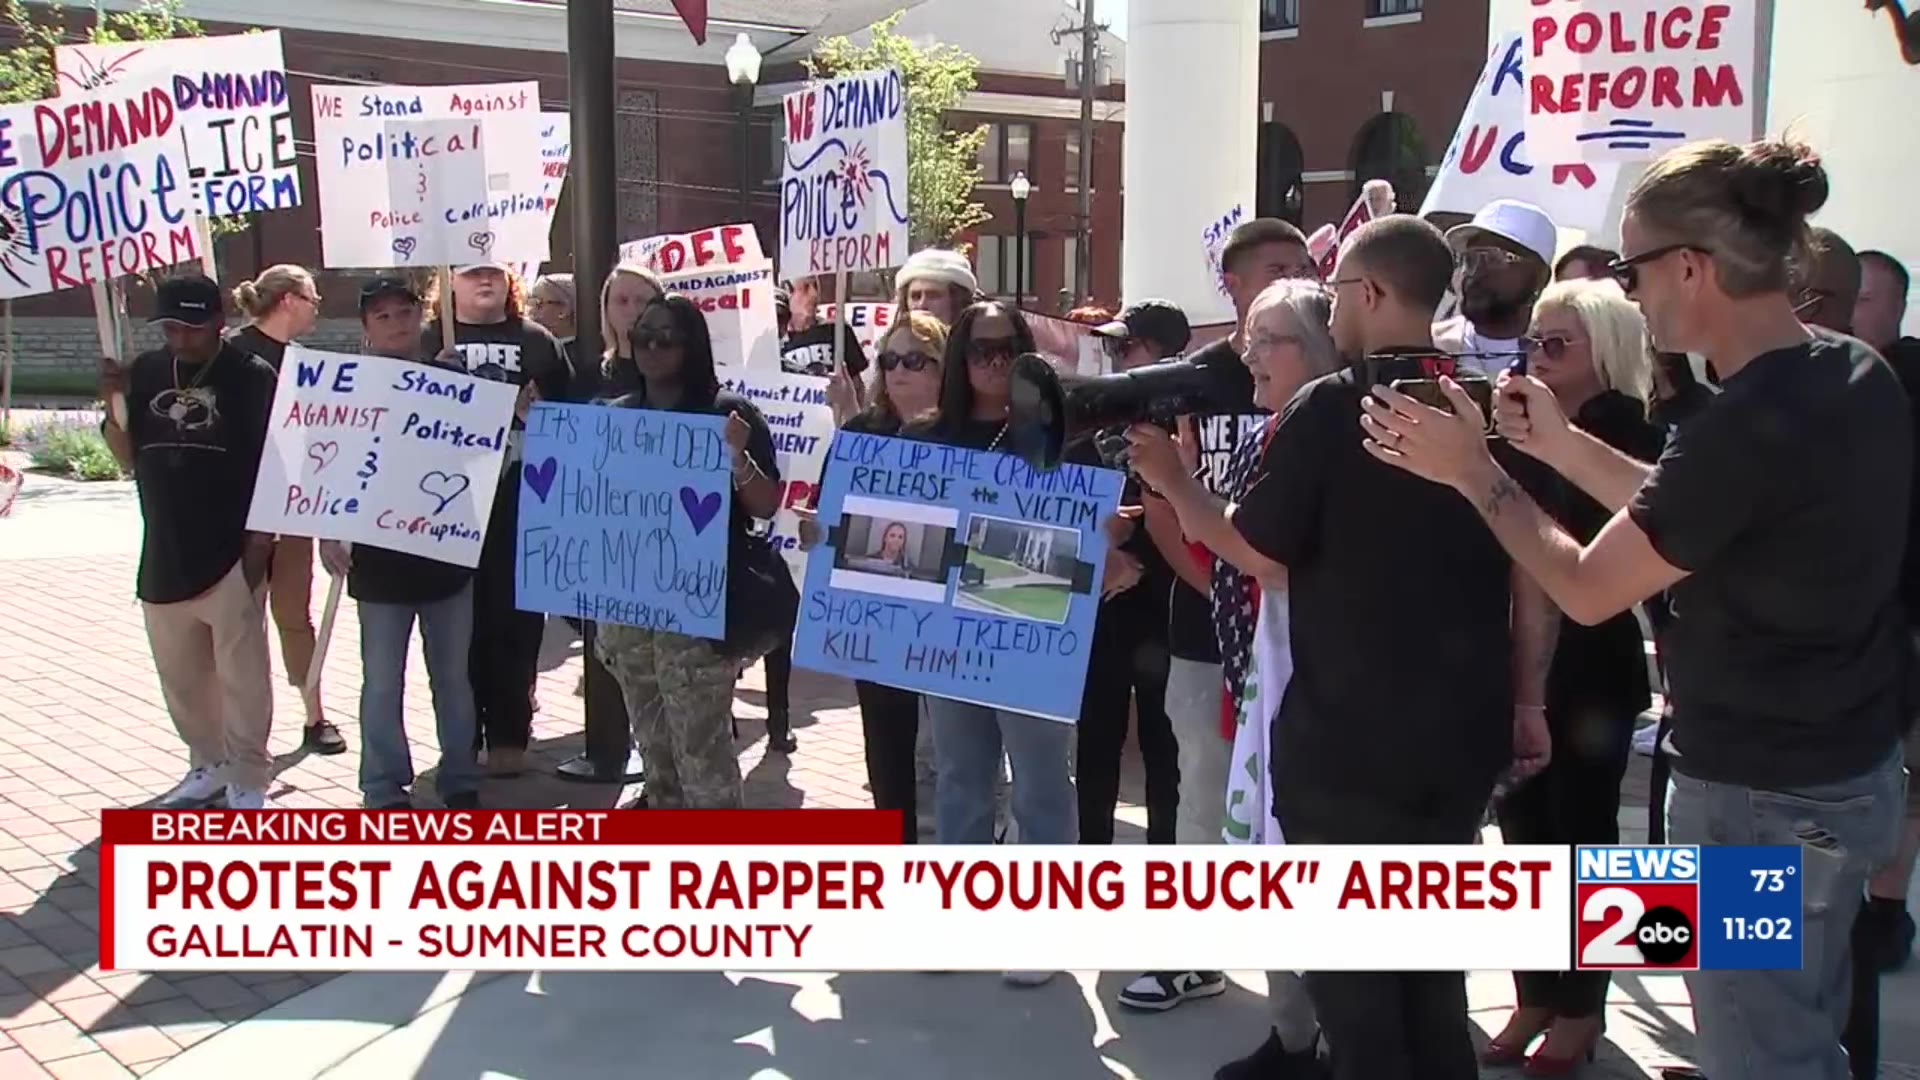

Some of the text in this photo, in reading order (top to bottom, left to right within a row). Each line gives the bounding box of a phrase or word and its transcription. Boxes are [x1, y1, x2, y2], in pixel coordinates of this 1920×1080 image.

[1533, 5, 1730, 57] POLICE
[316, 90, 528, 118] WE Stand Against
[786, 69, 900, 145] WE DEMAND
[1530, 64, 1744, 115] REFORM
[0, 87, 174, 168] E DEMAND
[181, 112, 298, 178] LICE
[191, 173, 297, 216] FORM
[370, 210, 423, 229] Police
[46, 226, 195, 290] REFORM
[809, 230, 890, 272] REFORM
[296, 359, 475, 404] WE Stand
[283, 400, 389, 432] AGANIST
[528, 407, 579, 445] It's
[834, 433, 891, 467] LOCK
[899, 442, 931, 470] UP
[935, 446, 985, 480] THE
[994, 454, 1108, 499] CRIMINAL
[284, 484, 359, 516] Police
[560, 463, 673, 530] Hollering
[850, 466, 956, 501] RELEASE
[971, 486, 1000, 505] the
[1015, 491, 1100, 531] VICTIM
[376, 509, 480, 542] Corruption
[601, 528, 641, 592] MY
[646, 527, 727, 619] Daddy
[808, 591, 933, 638] SHORTY
[823, 631, 996, 683] KILL HIM!!!
